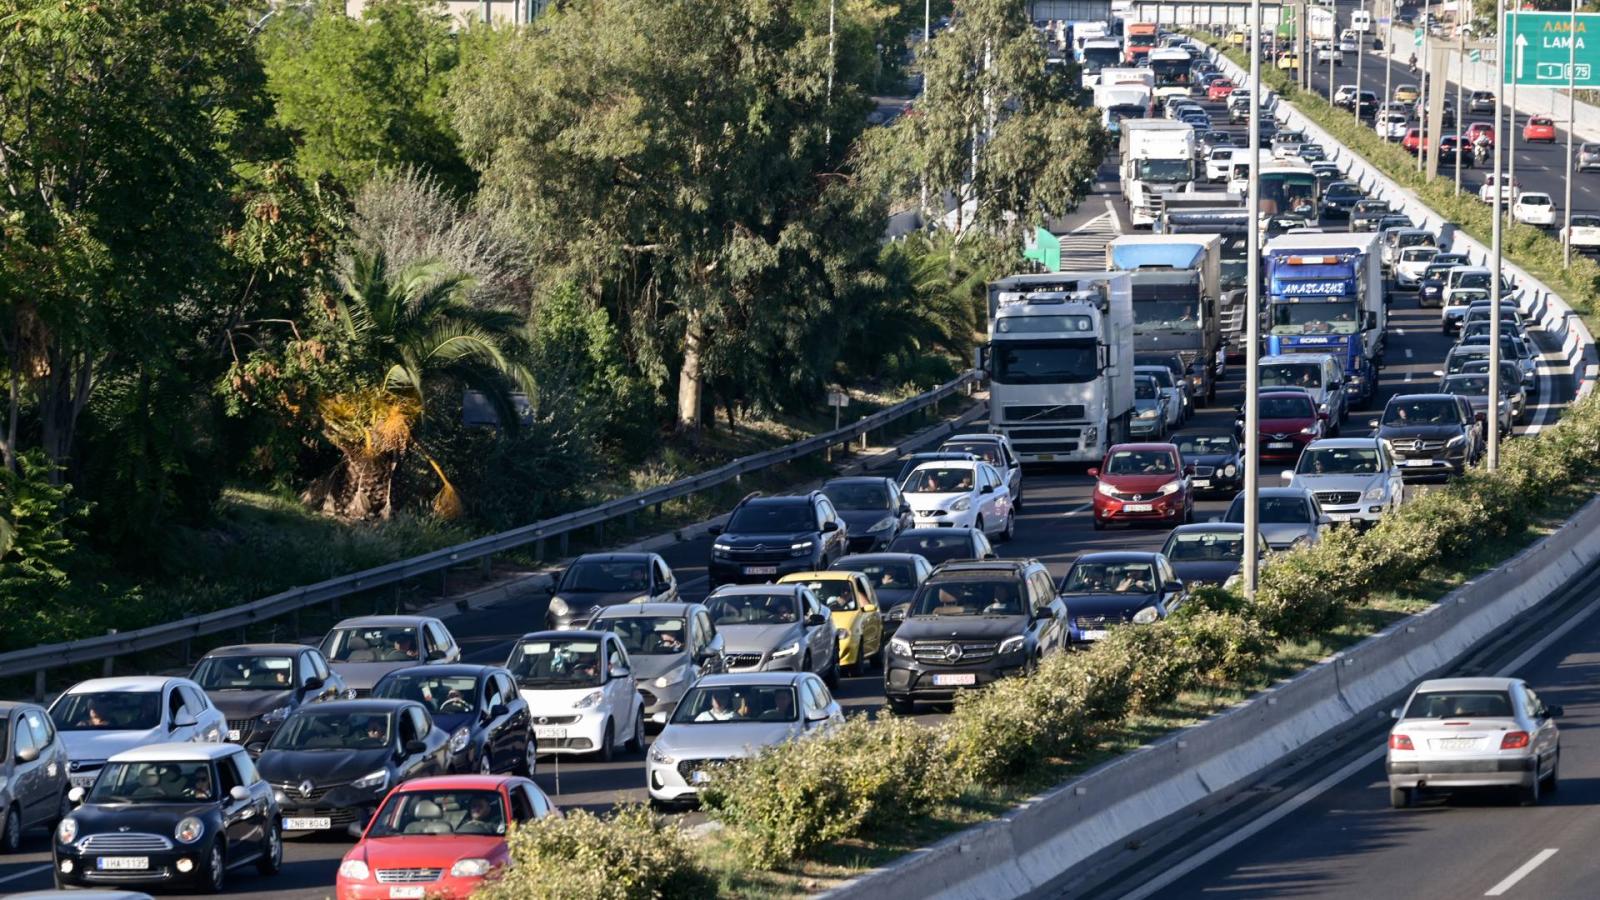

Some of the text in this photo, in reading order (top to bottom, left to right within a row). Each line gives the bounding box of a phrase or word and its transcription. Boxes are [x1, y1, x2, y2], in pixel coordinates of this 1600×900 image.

[1543, 21, 1586, 32] ΛΑΜΑ
[1543, 36, 1585, 49] LAMA
[1548, 65, 1553, 76] 1
